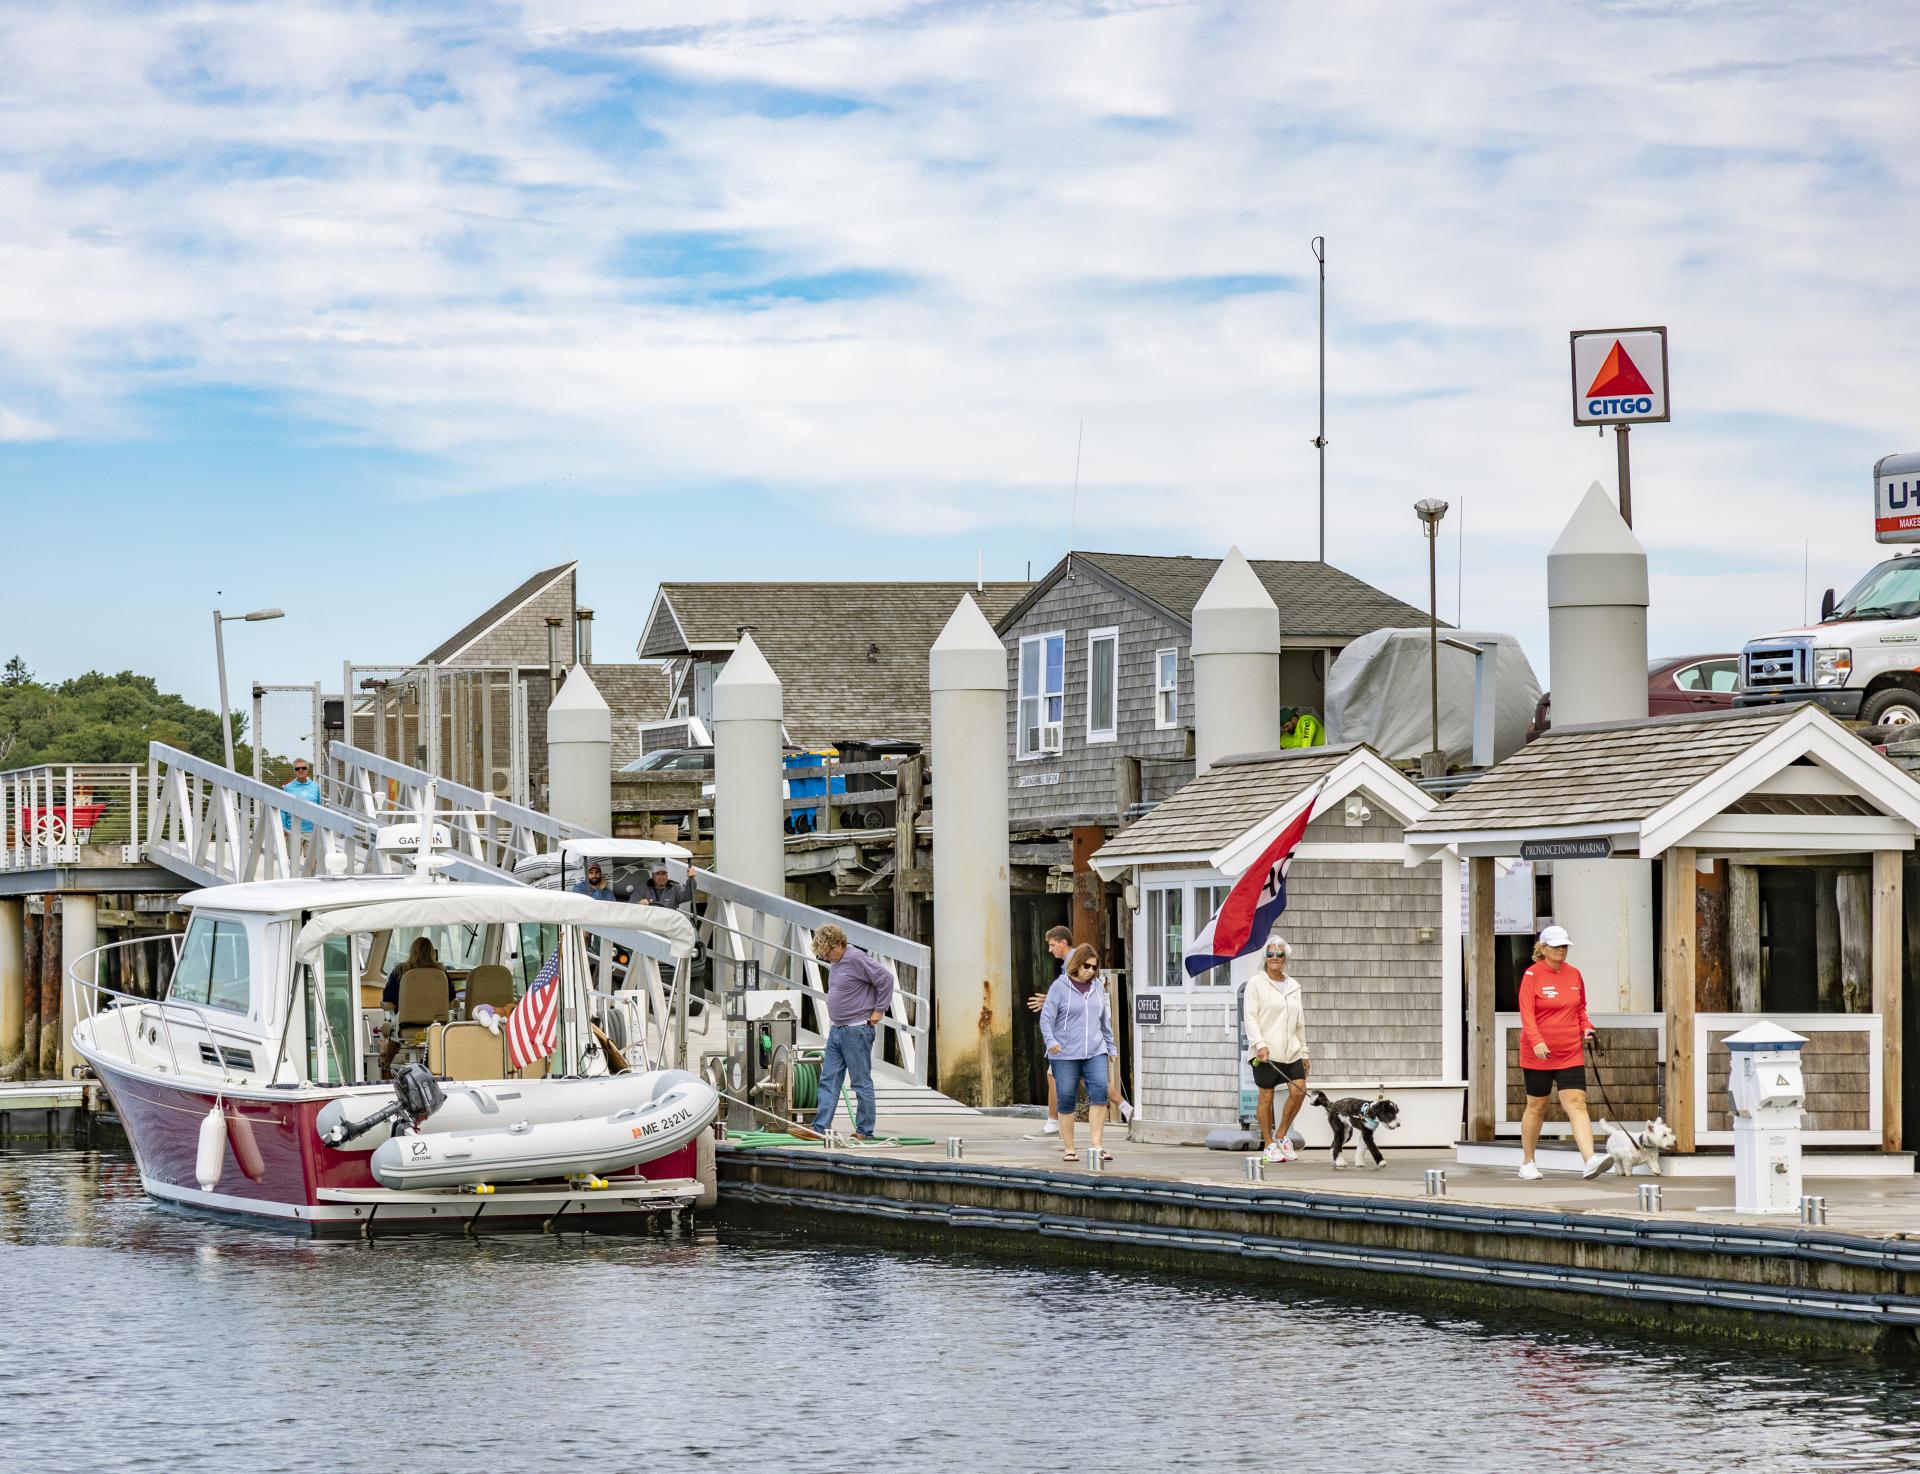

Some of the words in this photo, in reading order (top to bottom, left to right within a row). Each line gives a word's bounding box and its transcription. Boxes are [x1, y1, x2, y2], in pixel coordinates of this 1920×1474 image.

[1589, 397, 1652, 416] CITGO
[398, 836, 443, 845] GAIN
[1525, 844, 1578, 856] PROVINCETOWN
[1579, 842, 1606, 854] MARINA
[1137, 999, 1160, 1011] OFFICE
[641, 1122, 660, 1136] ME
[661, 1108, 693, 1130] 252VL
